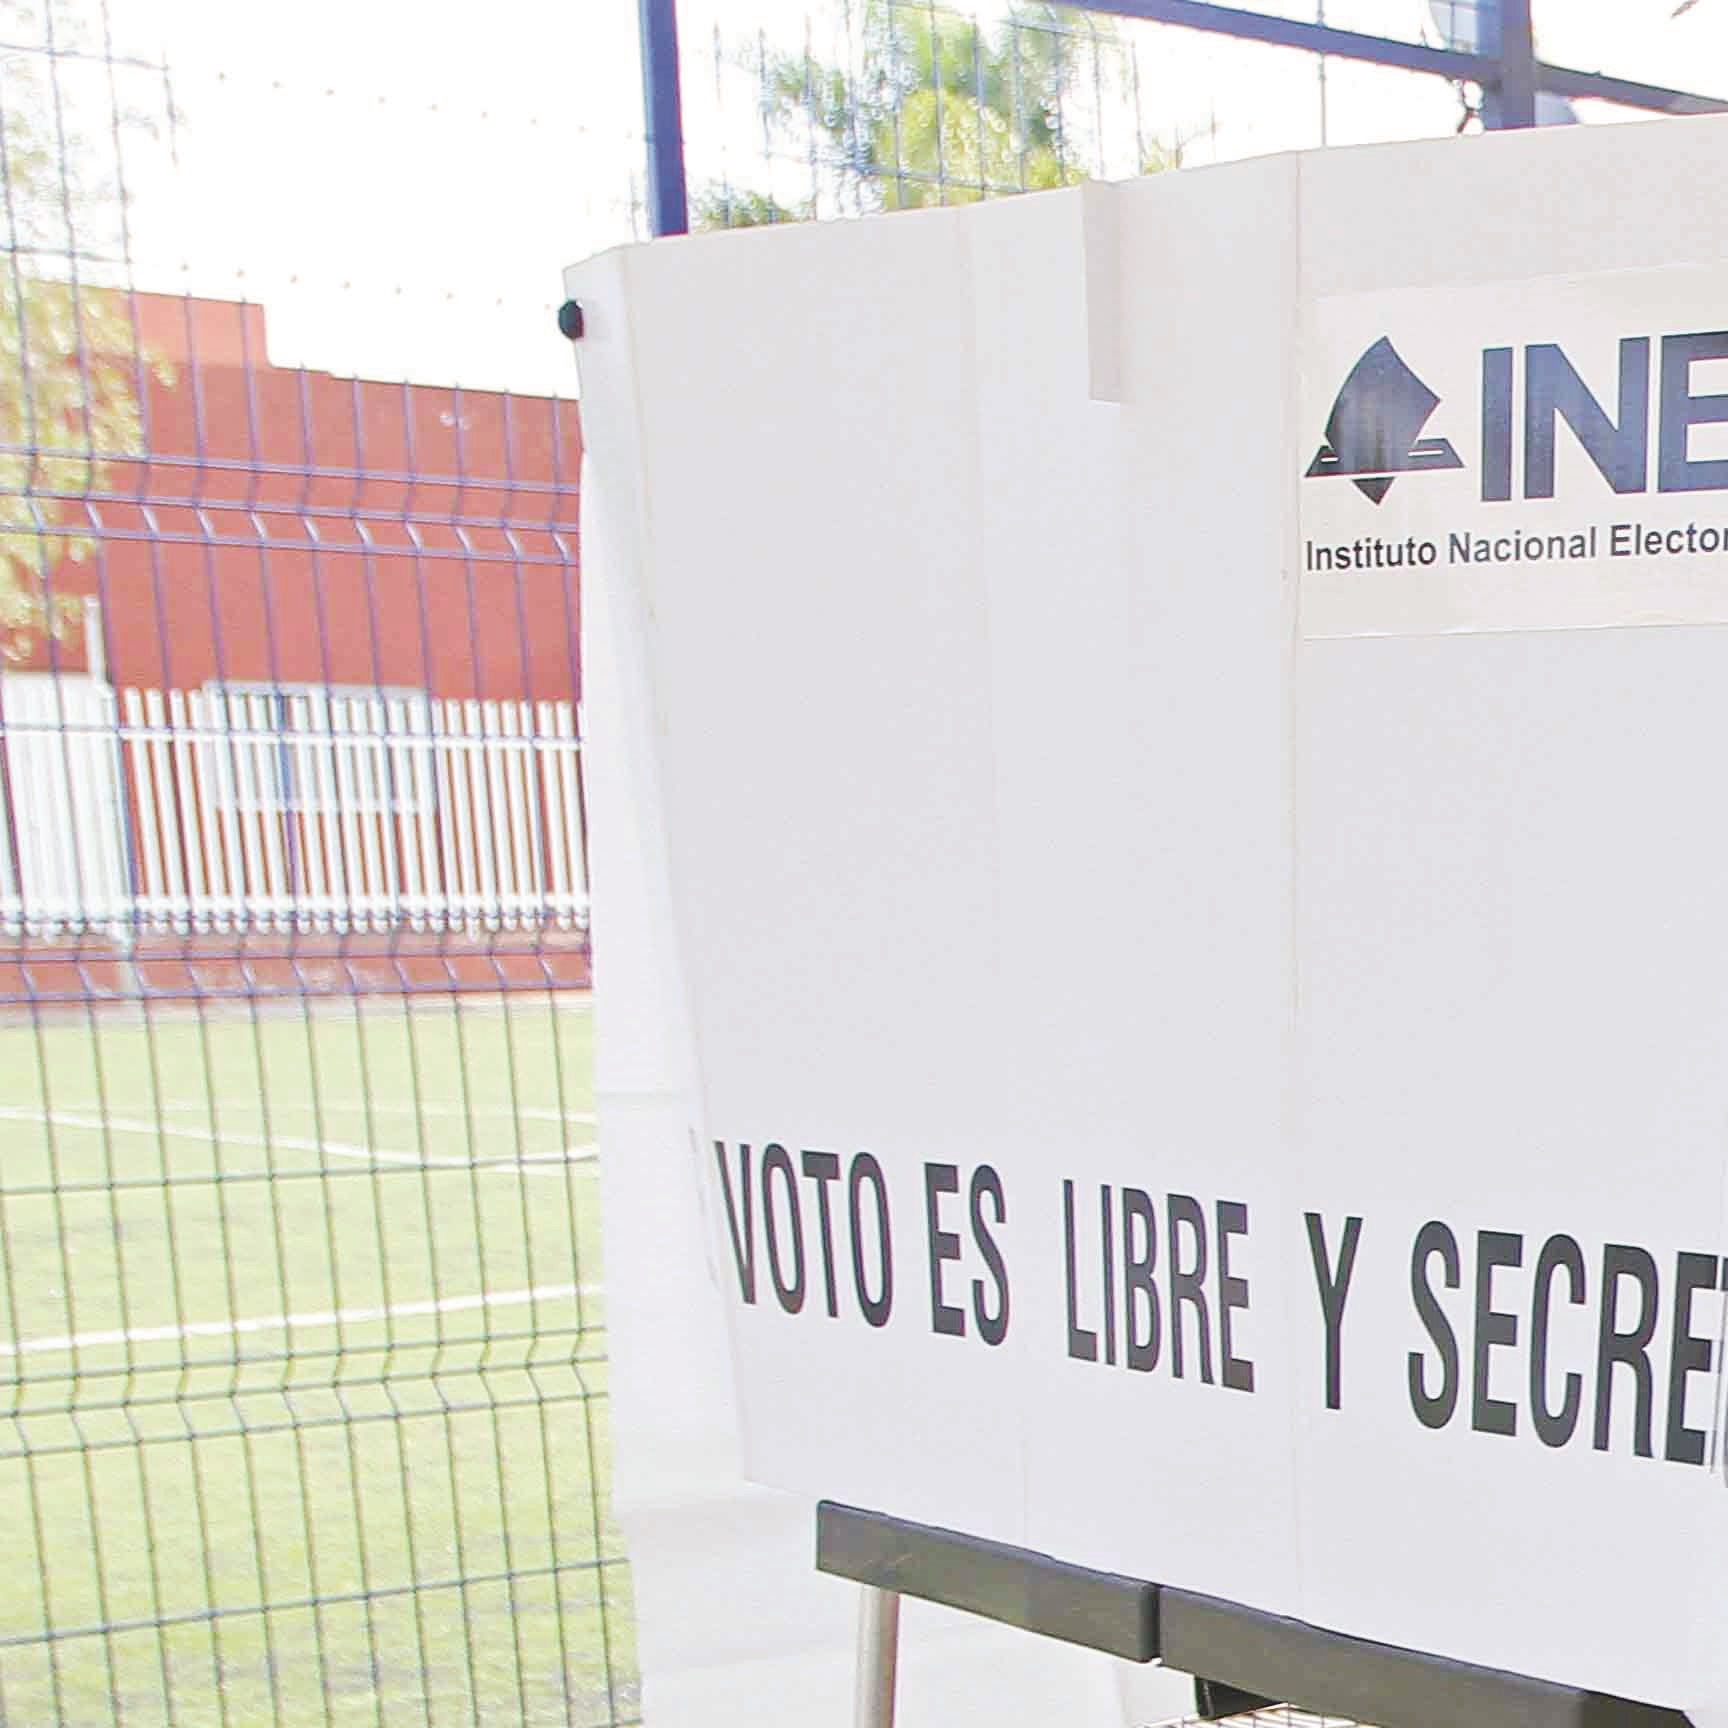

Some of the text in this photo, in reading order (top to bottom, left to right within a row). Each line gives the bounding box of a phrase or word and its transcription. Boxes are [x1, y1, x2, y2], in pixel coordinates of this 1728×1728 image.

[1305, 538, 1437, 572] Instituto
[1448, 526, 1597, 565] Nacional
[714, 1140, 894, 1329] VOTO
[924, 1162, 1009, 1347] ES
[1063, 1178, 1255, 1394] LIBRE
[1304, 1212, 1362, 1412] Y
